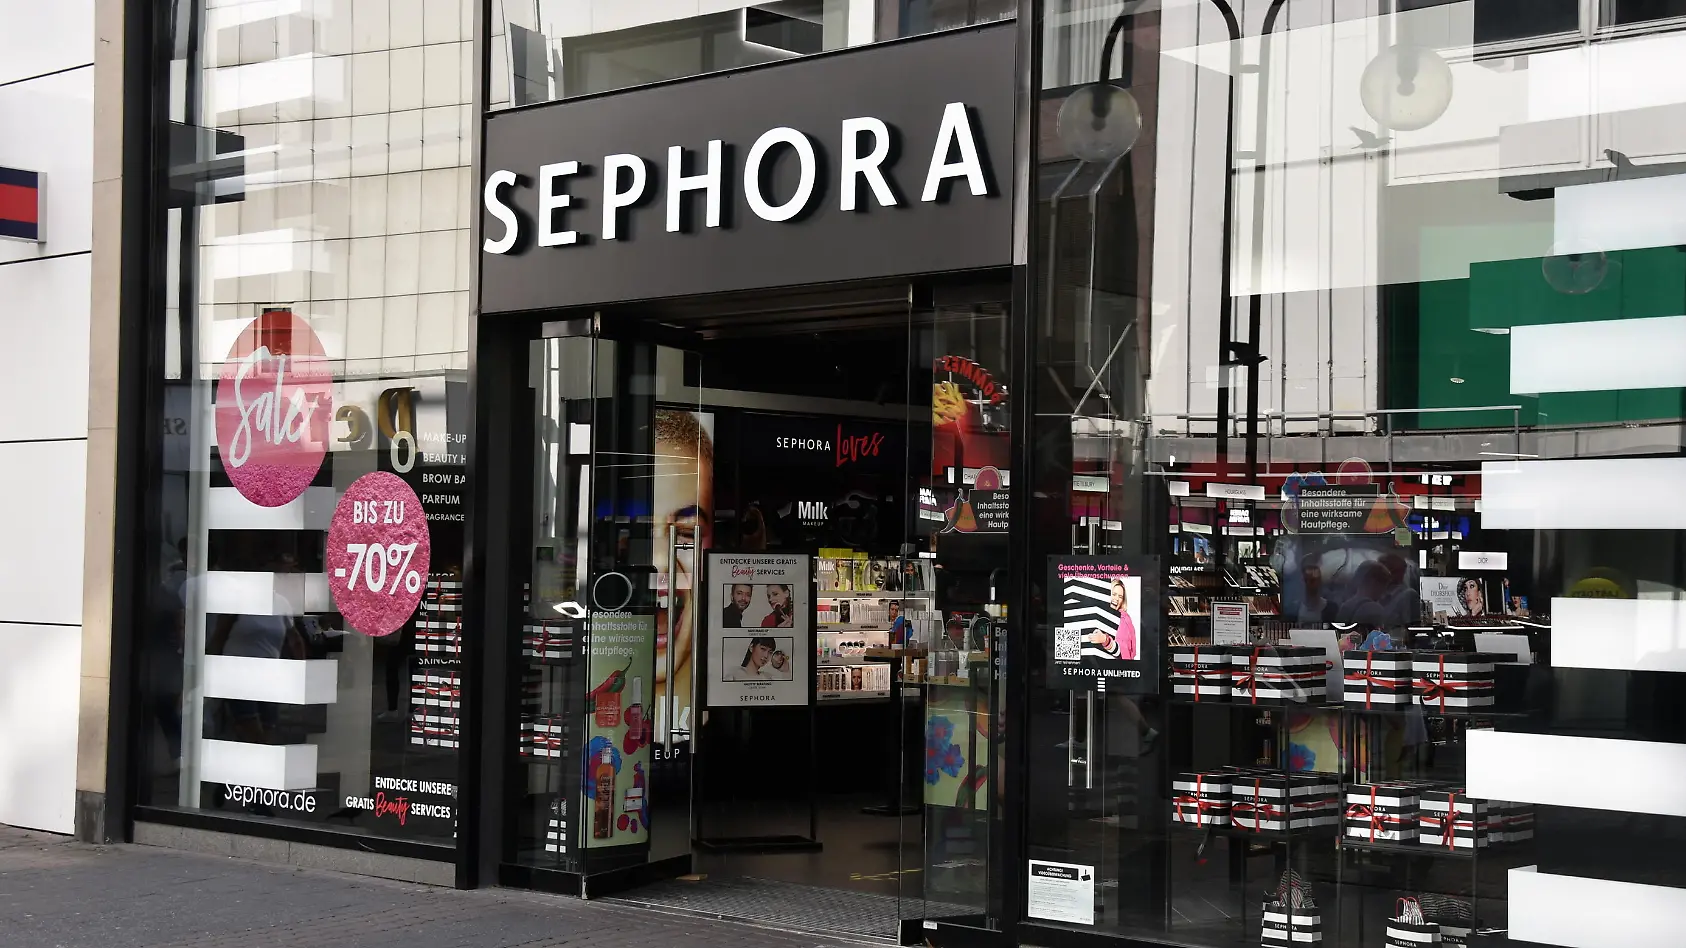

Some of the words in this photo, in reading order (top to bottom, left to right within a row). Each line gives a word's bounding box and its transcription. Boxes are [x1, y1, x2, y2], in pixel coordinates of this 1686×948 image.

[483, 101, 988, 255] SEPHORA
[228, 345, 319, 468] Sale
[423, 431, 467, 444] MAKE-UP
[776, 436, 831, 451] SEPHORA
[836, 423, 885, 467] Loves
[423, 453, 457, 464] BEAUTY
[423, 474, 451, 484] BROW
[1301, 489, 1346, 497] Besondere
[422, 494, 460, 504] PARFUM
[1301, 499, 1352, 508] Inhaltsstoffe
[1354, 498, 1366, 507] für
[353, 500, 378, 524] BIS
[383, 500, 405, 524] ZU
[798, 501, 828, 520] Milk
[979, 511, 994, 519] eine
[1300, 510, 1319, 518] eine
[1322, 509, 1362, 518] wirksame
[425, 513, 465, 521] RAGRANCE
[1300, 520, 1350, 530] Hautpflege.
[334, 543, 421, 595] -70%
[819, 561, 835, 571] Milk
[1058, 564, 1096, 572] Geschenke,
[757, 568, 785, 576] SERVICES
[1063, 668, 1101, 676] SEPHORA
[1103, 669, 1140, 678] UNLIMITED
[375, 776, 418, 792] ENTDECKE
[419, 780, 452, 796] UNSERE
[224, 780, 316, 813] Sephora.de
[345, 795, 375, 811] GRATIS
[375, 791, 409, 826] Beauty
[410, 802, 451, 819] SERVICES
[1394, 939, 1417, 947] SEPHORA
